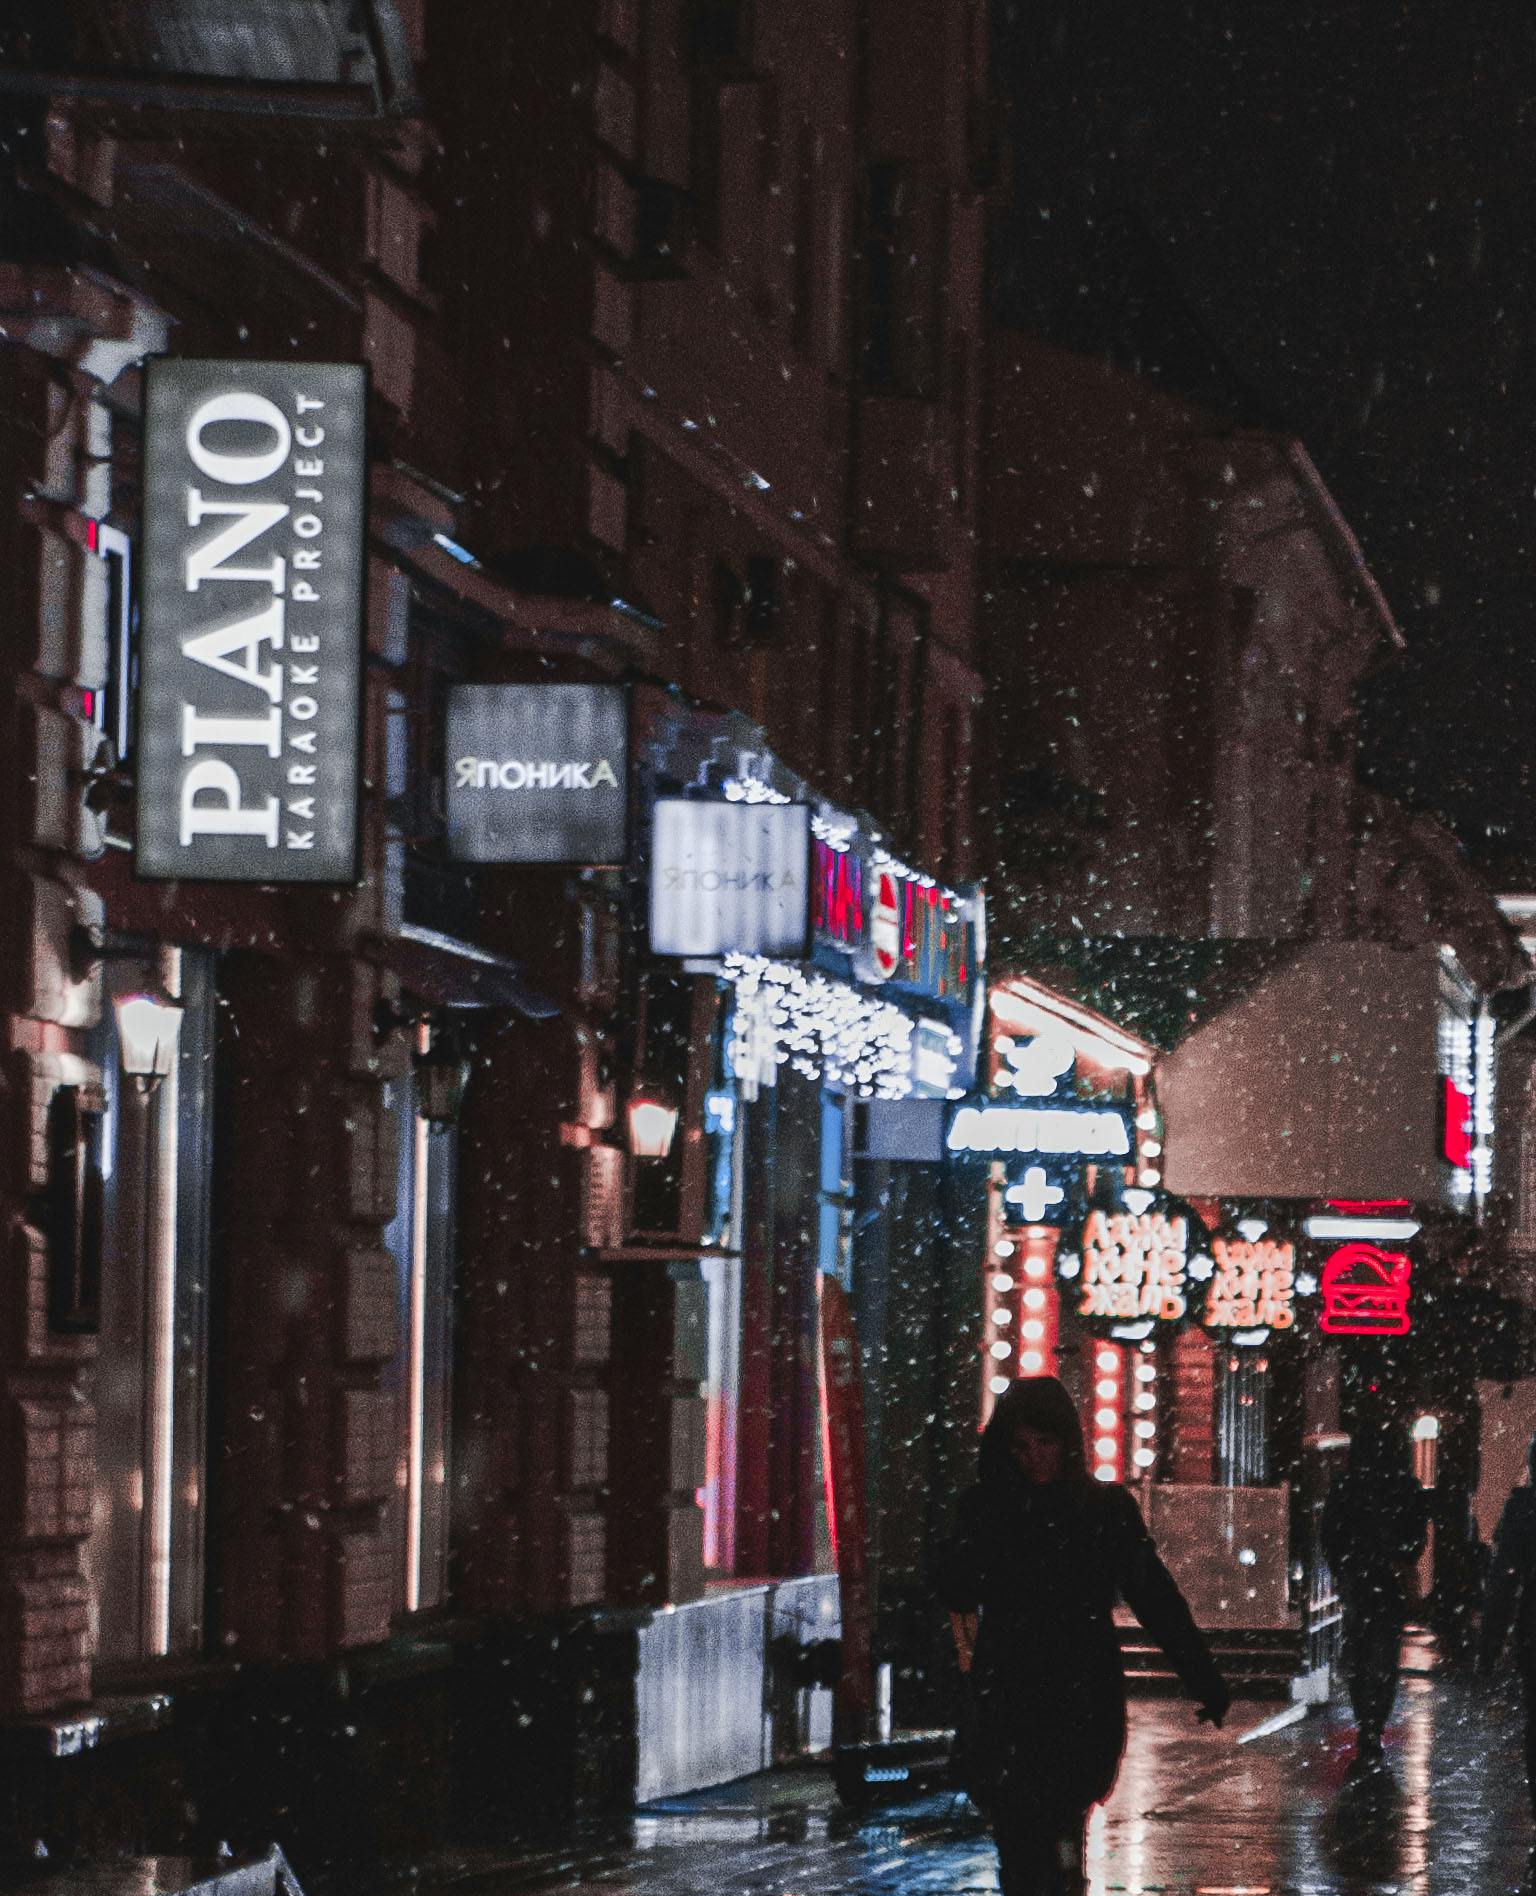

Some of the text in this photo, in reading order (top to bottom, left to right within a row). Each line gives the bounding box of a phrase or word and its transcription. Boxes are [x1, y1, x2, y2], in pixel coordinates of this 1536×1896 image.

[179, 390, 292, 849] PIANO
[287, 393, 326, 851] KARAOKE PROJECT
[454, 755, 619, 790] ЯПОНИКА
